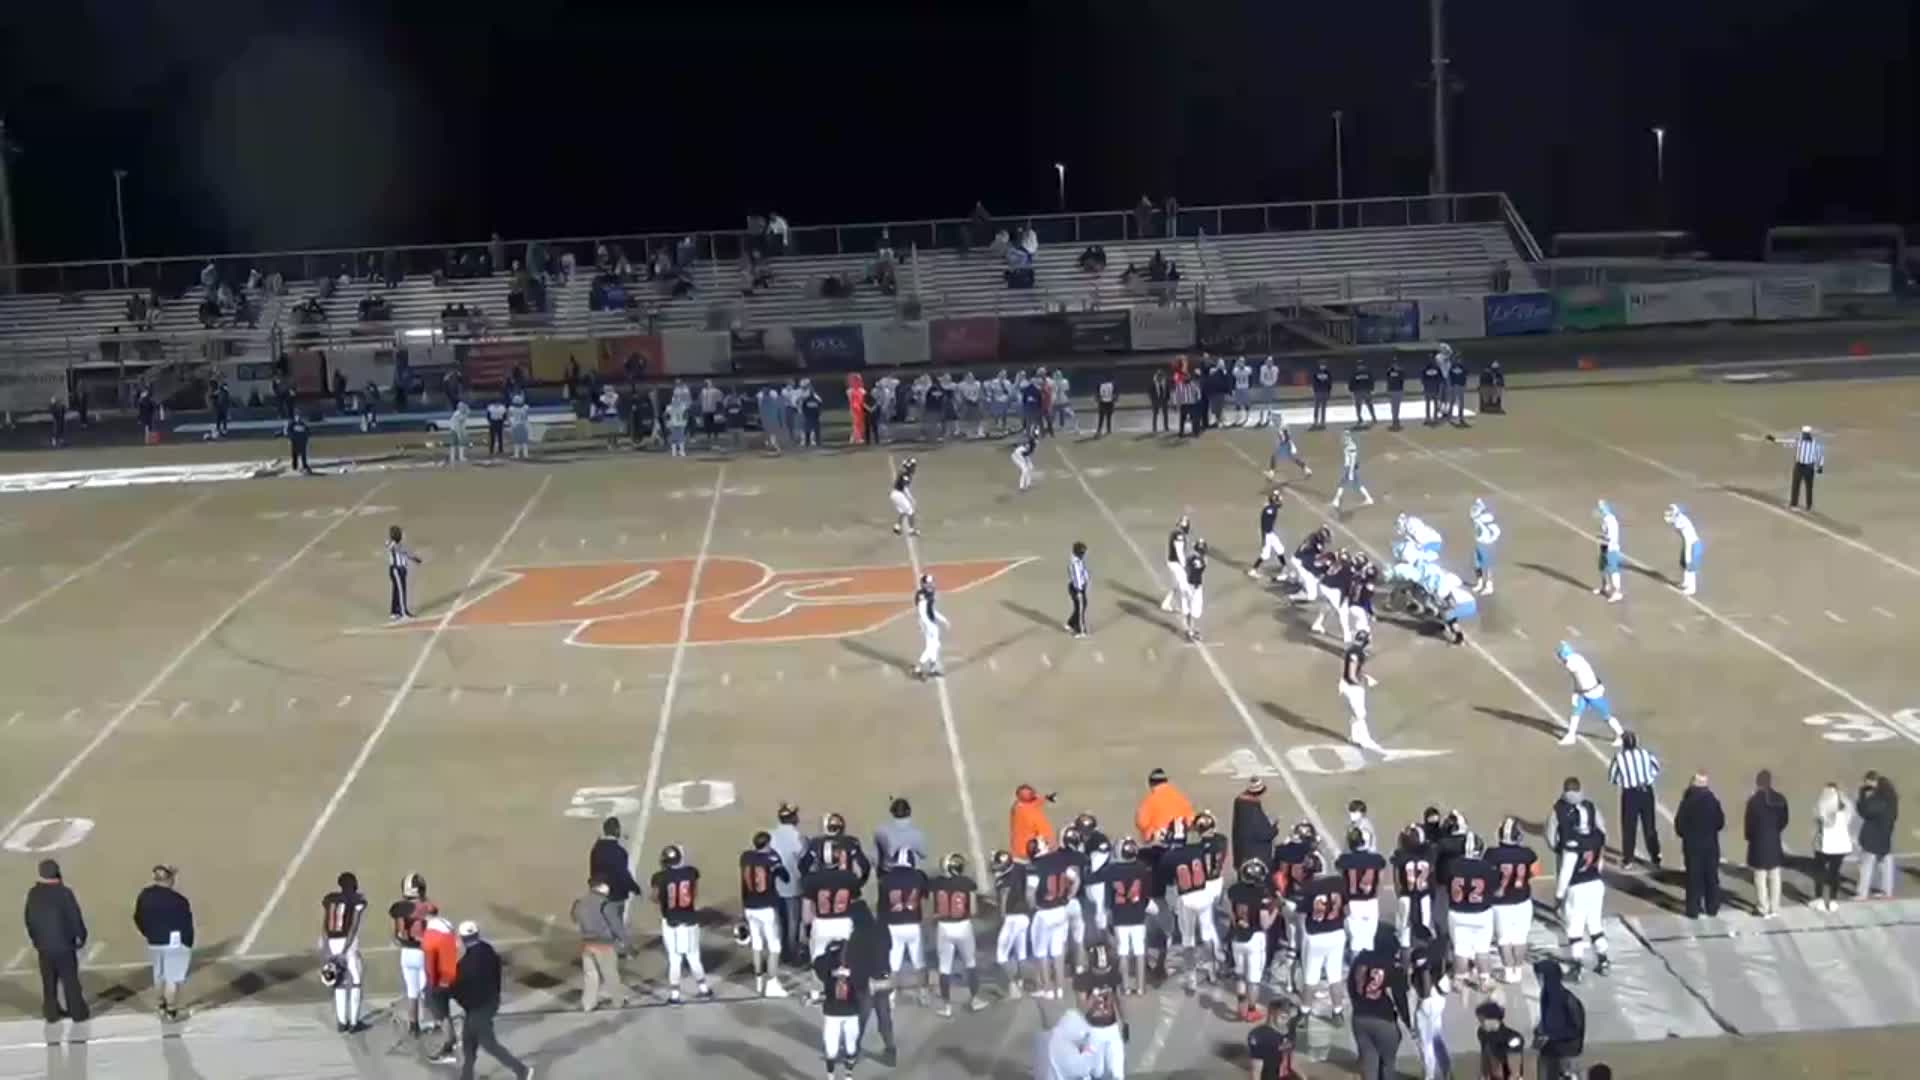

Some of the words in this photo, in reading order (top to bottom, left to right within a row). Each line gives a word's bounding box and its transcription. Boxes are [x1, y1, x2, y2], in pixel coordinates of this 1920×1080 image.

[563, 780, 736, 819] 50
[1347, 867, 1376, 895] 14
[1450, 877, 1485, 904] 62
